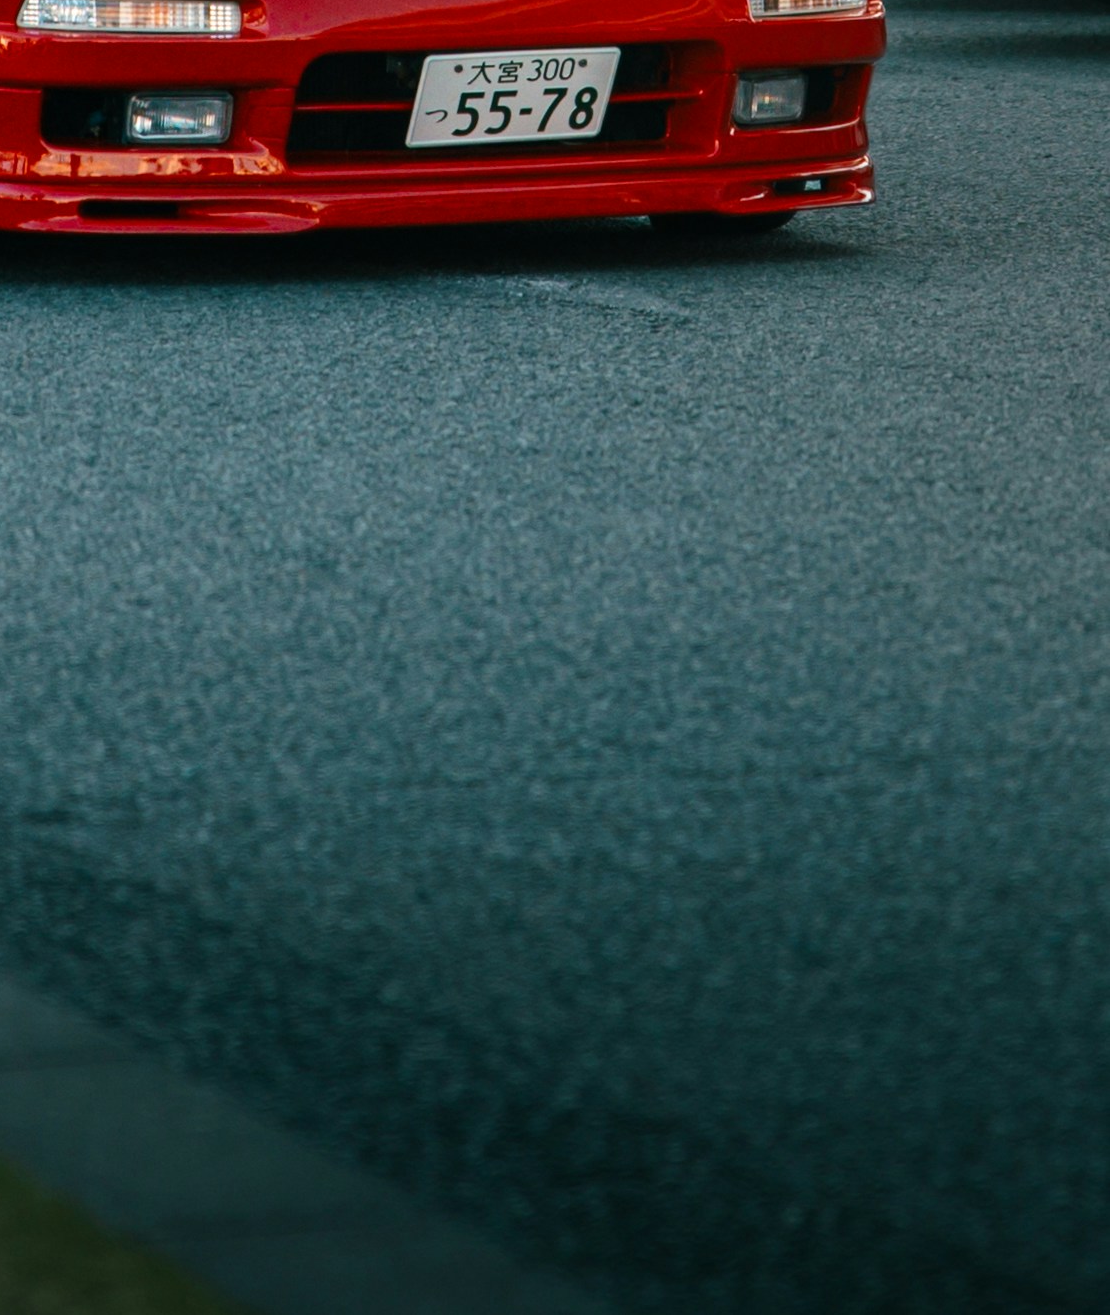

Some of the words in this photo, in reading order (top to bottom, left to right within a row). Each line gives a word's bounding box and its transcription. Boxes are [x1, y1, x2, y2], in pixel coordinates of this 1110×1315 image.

[467, 60, 523, 85] 大宮
[526, 57, 575, 82] 300
[425, 109, 448, 123] つ
[451, 86, 598, 137] 55-78
